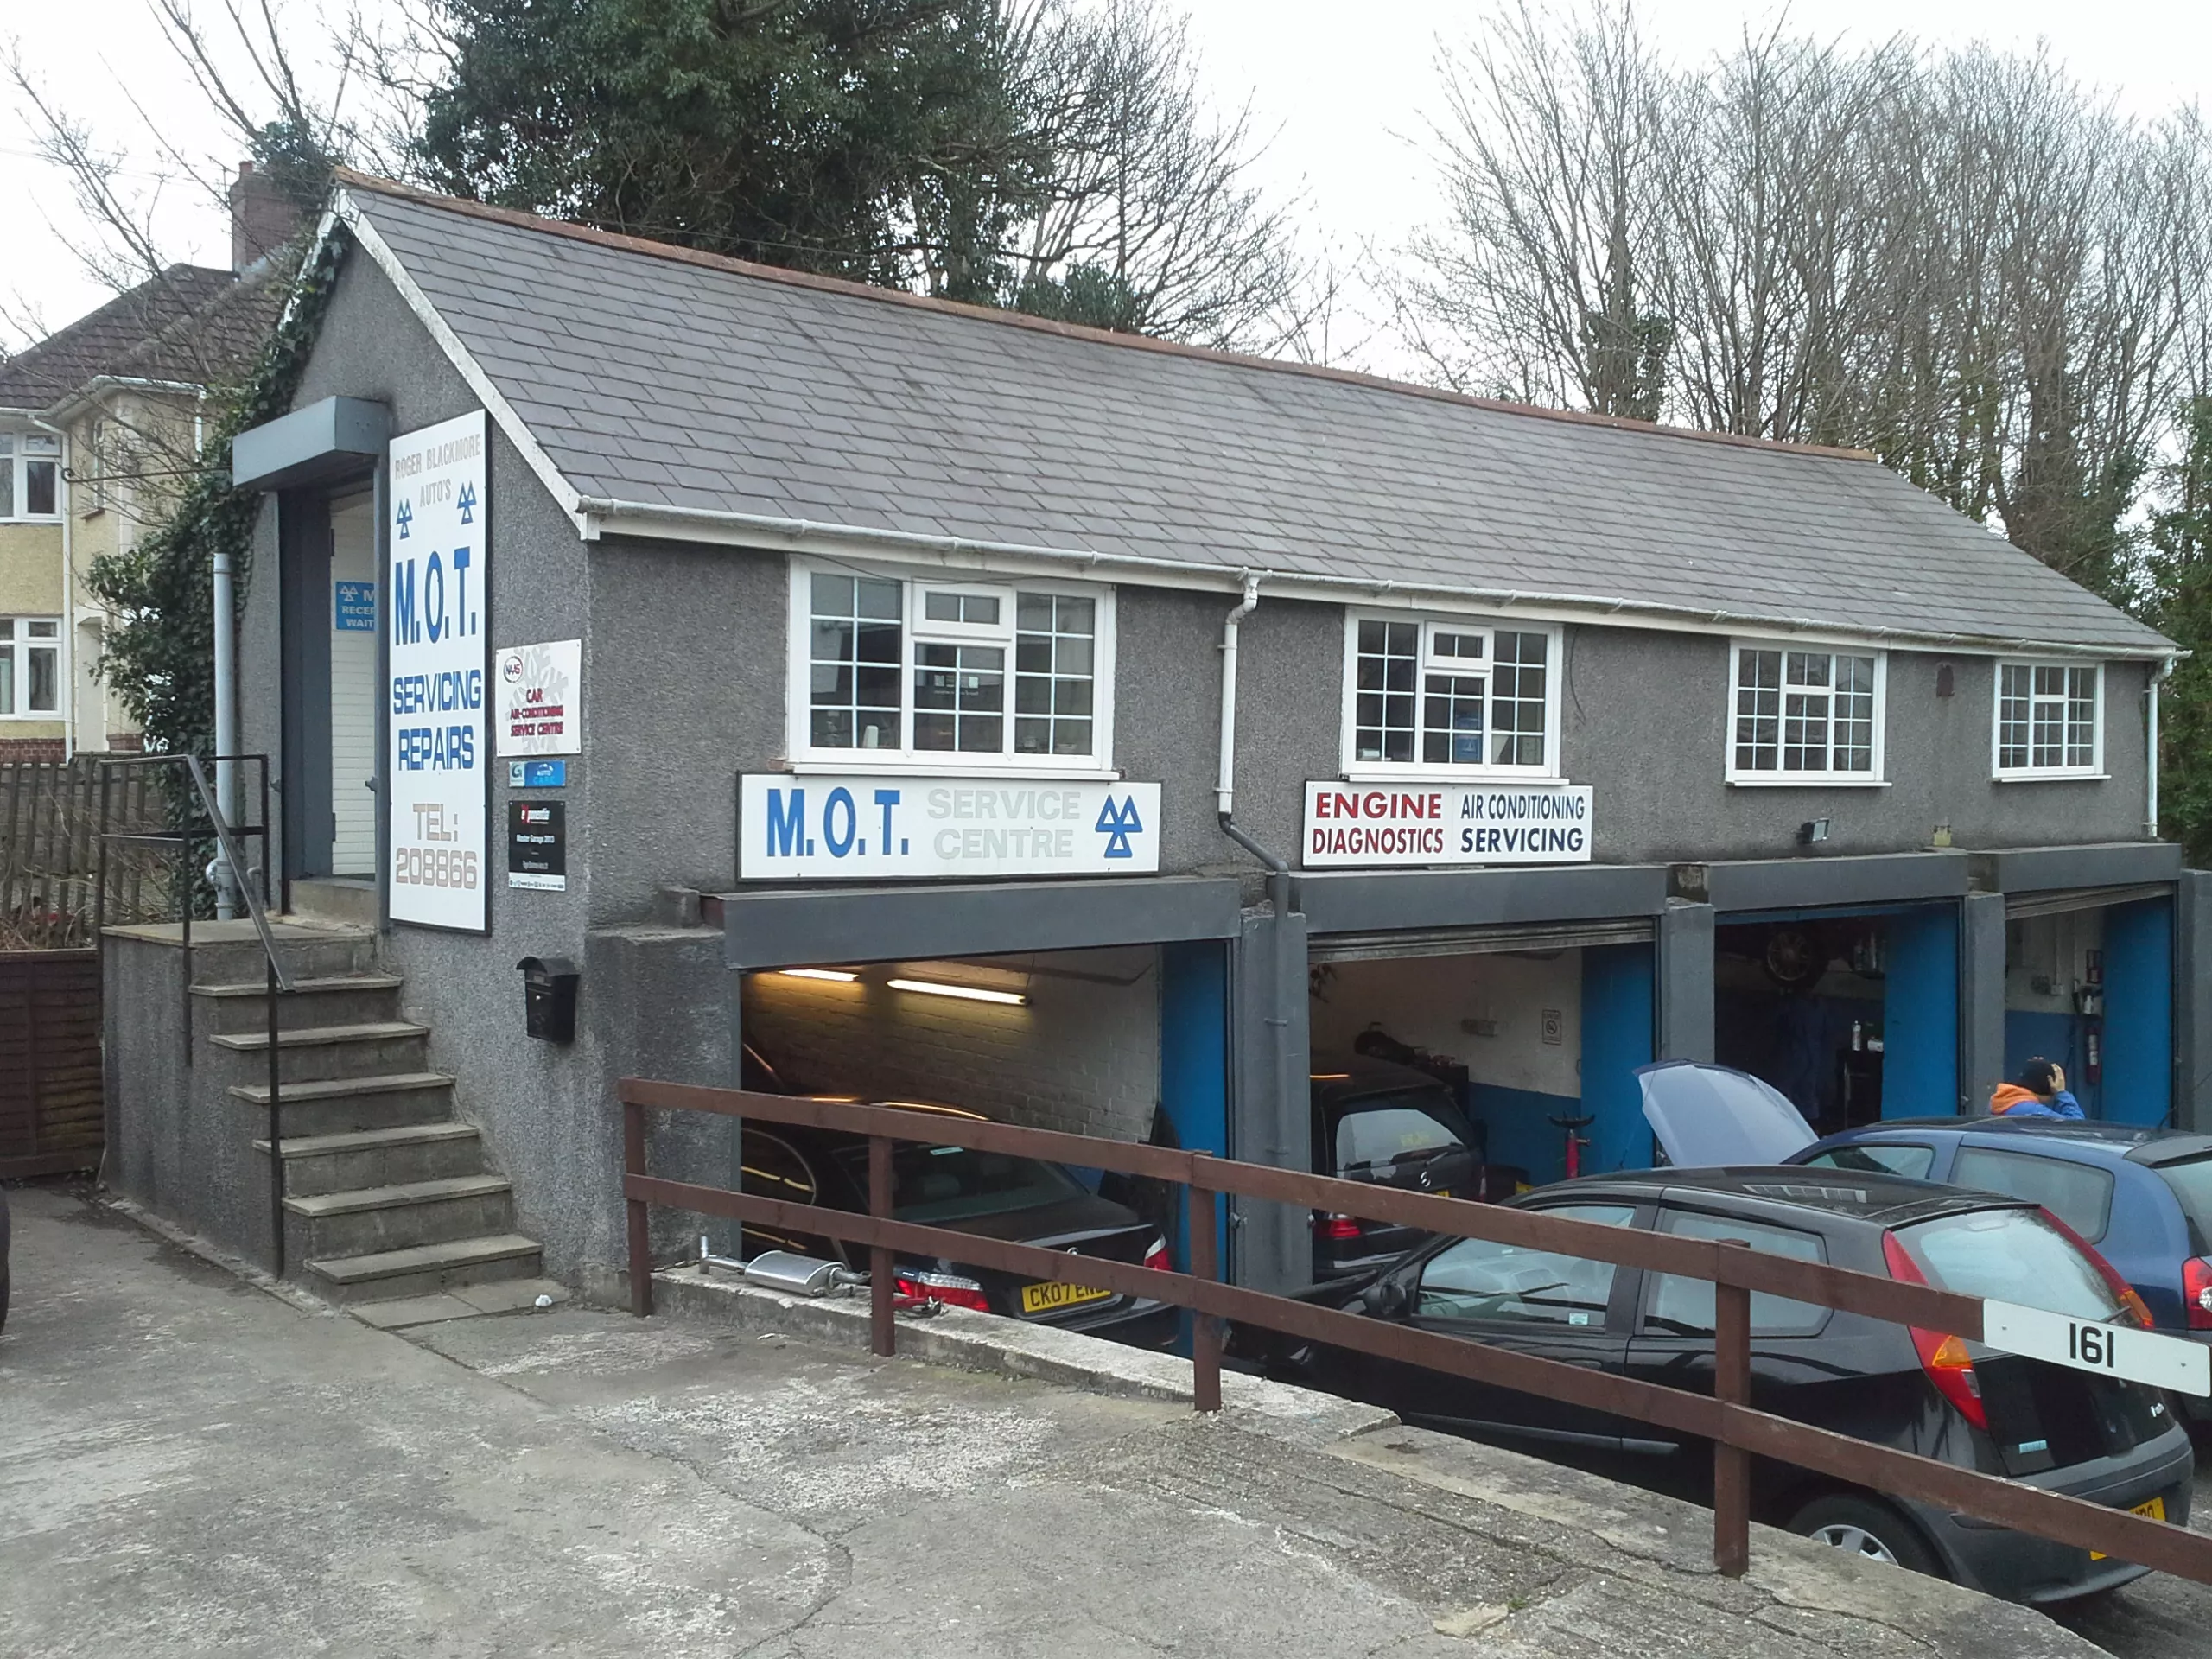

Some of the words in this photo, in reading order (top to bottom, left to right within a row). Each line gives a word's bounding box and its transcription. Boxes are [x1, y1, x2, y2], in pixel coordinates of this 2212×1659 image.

[395, 453, 422, 480] ROGER
[426, 434, 480, 470] BLACKMORE
[419, 478, 451, 507] AUTO'S
[396, 546, 476, 646] M.O.T.
[393, 669, 481, 715] SERVICING
[526, 688, 543, 703] CAR
[511, 723, 536, 737] SERVICE
[537, 721, 563, 735] CENTRE
[398, 725, 474, 771] REPAIRS
[926, 788, 1081, 819] SERVICE
[1315, 792, 1442, 819] ENGINE
[1460, 794, 1483, 820] AIR
[1488, 794, 1585, 820] CONDITIONING
[412, 803, 458, 842] TEL:
[766, 786, 909, 858] M.O.T.
[933, 829, 1073, 859] CENTRE
[1312, 828, 1444, 855] DIAGNOSTICS
[1460, 827, 1584, 853] SERVICING
[396, 847, 477, 890] 208866
[1030, 1283, 1071, 1306] CK07
[2069, 1322, 2113, 1369] 161
